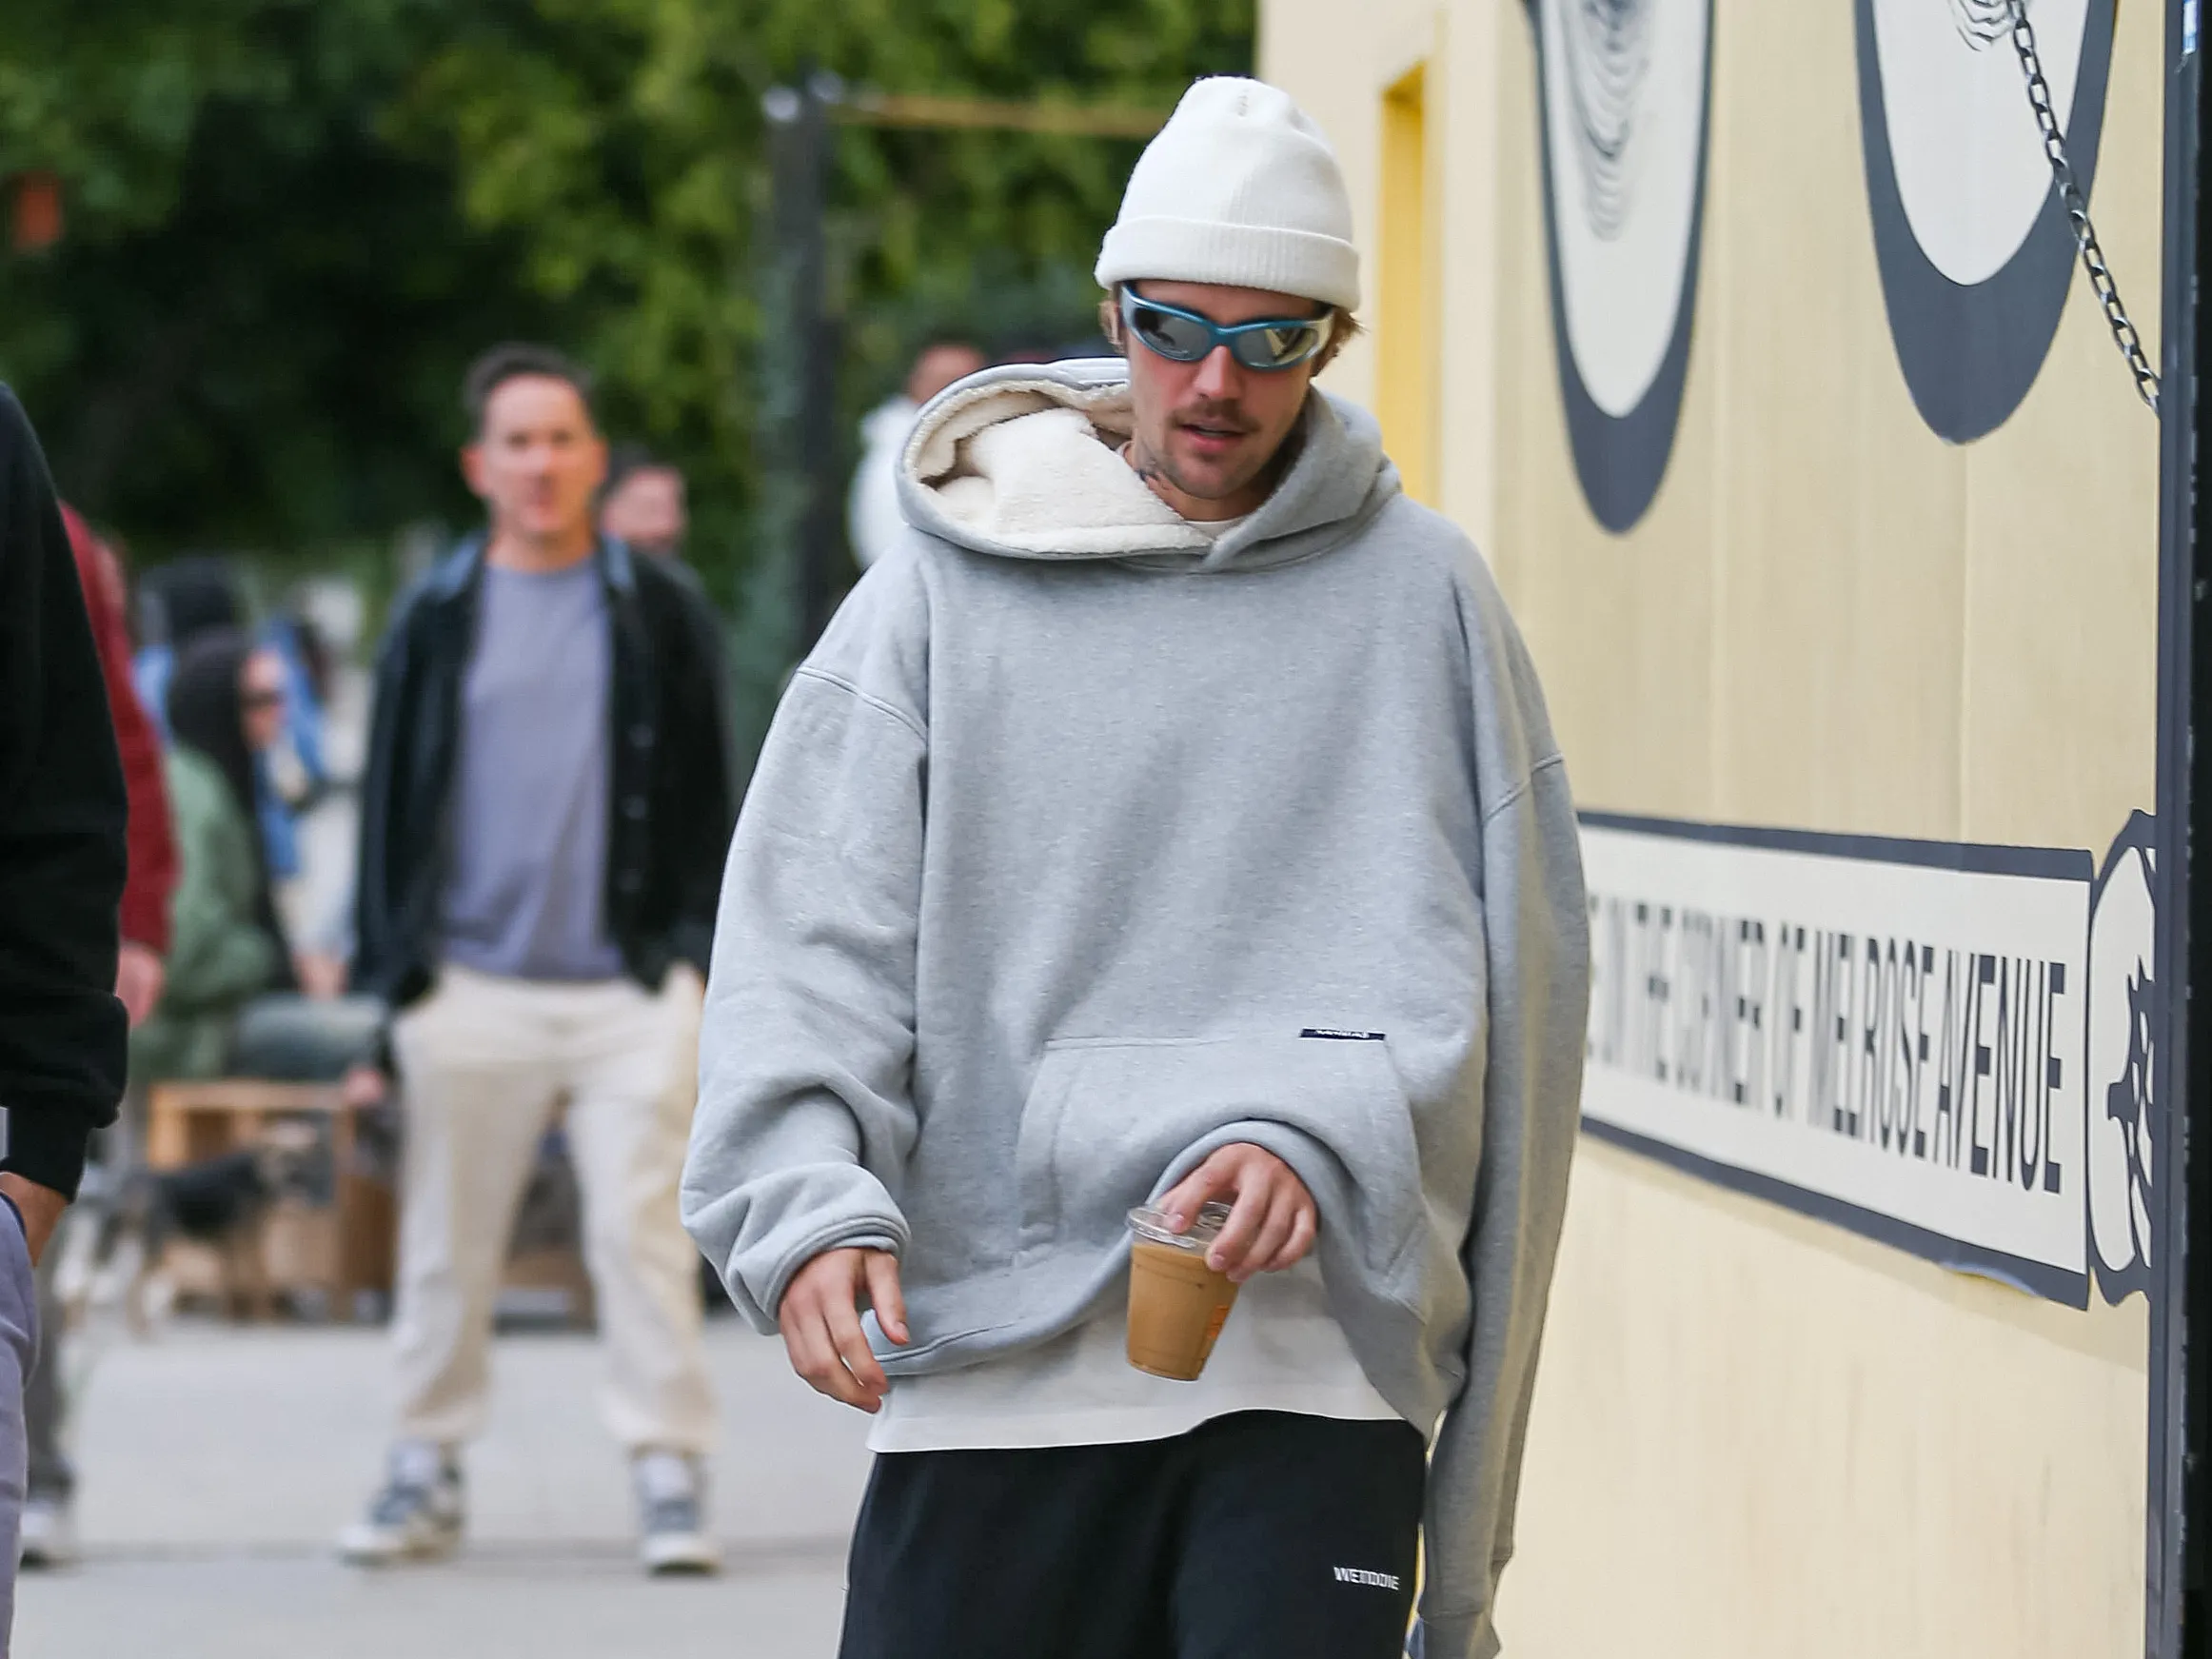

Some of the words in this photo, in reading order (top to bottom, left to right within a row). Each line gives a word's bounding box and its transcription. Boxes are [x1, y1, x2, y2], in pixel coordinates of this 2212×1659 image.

[1773, 919, 1806, 1121] OF
[1807, 927, 1934, 1160] MELROSE
[1932, 948, 2066, 1195] AVENUE
